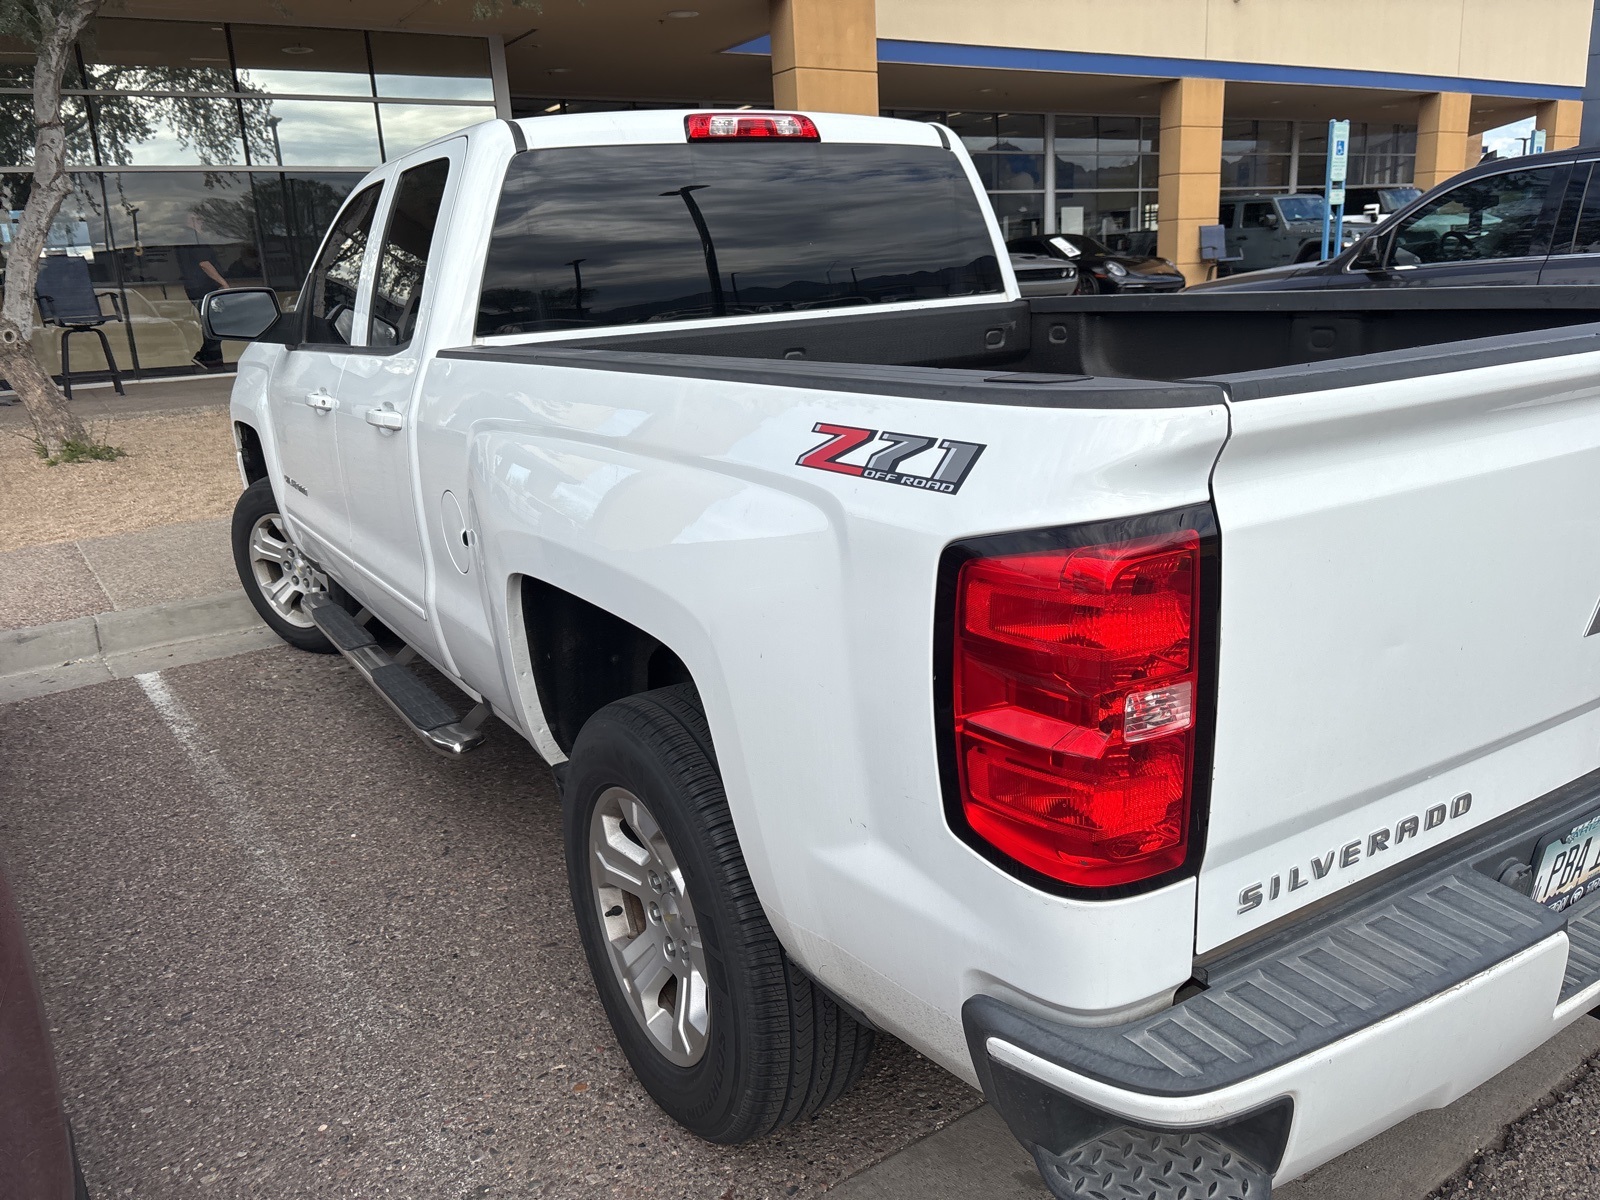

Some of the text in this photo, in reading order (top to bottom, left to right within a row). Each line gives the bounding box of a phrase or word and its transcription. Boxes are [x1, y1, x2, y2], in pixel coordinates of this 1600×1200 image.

[795, 421, 988, 485] Z71
[863, 469, 956, 493] OFF ROAD
[1236, 791, 1473, 916] SILVERADO
